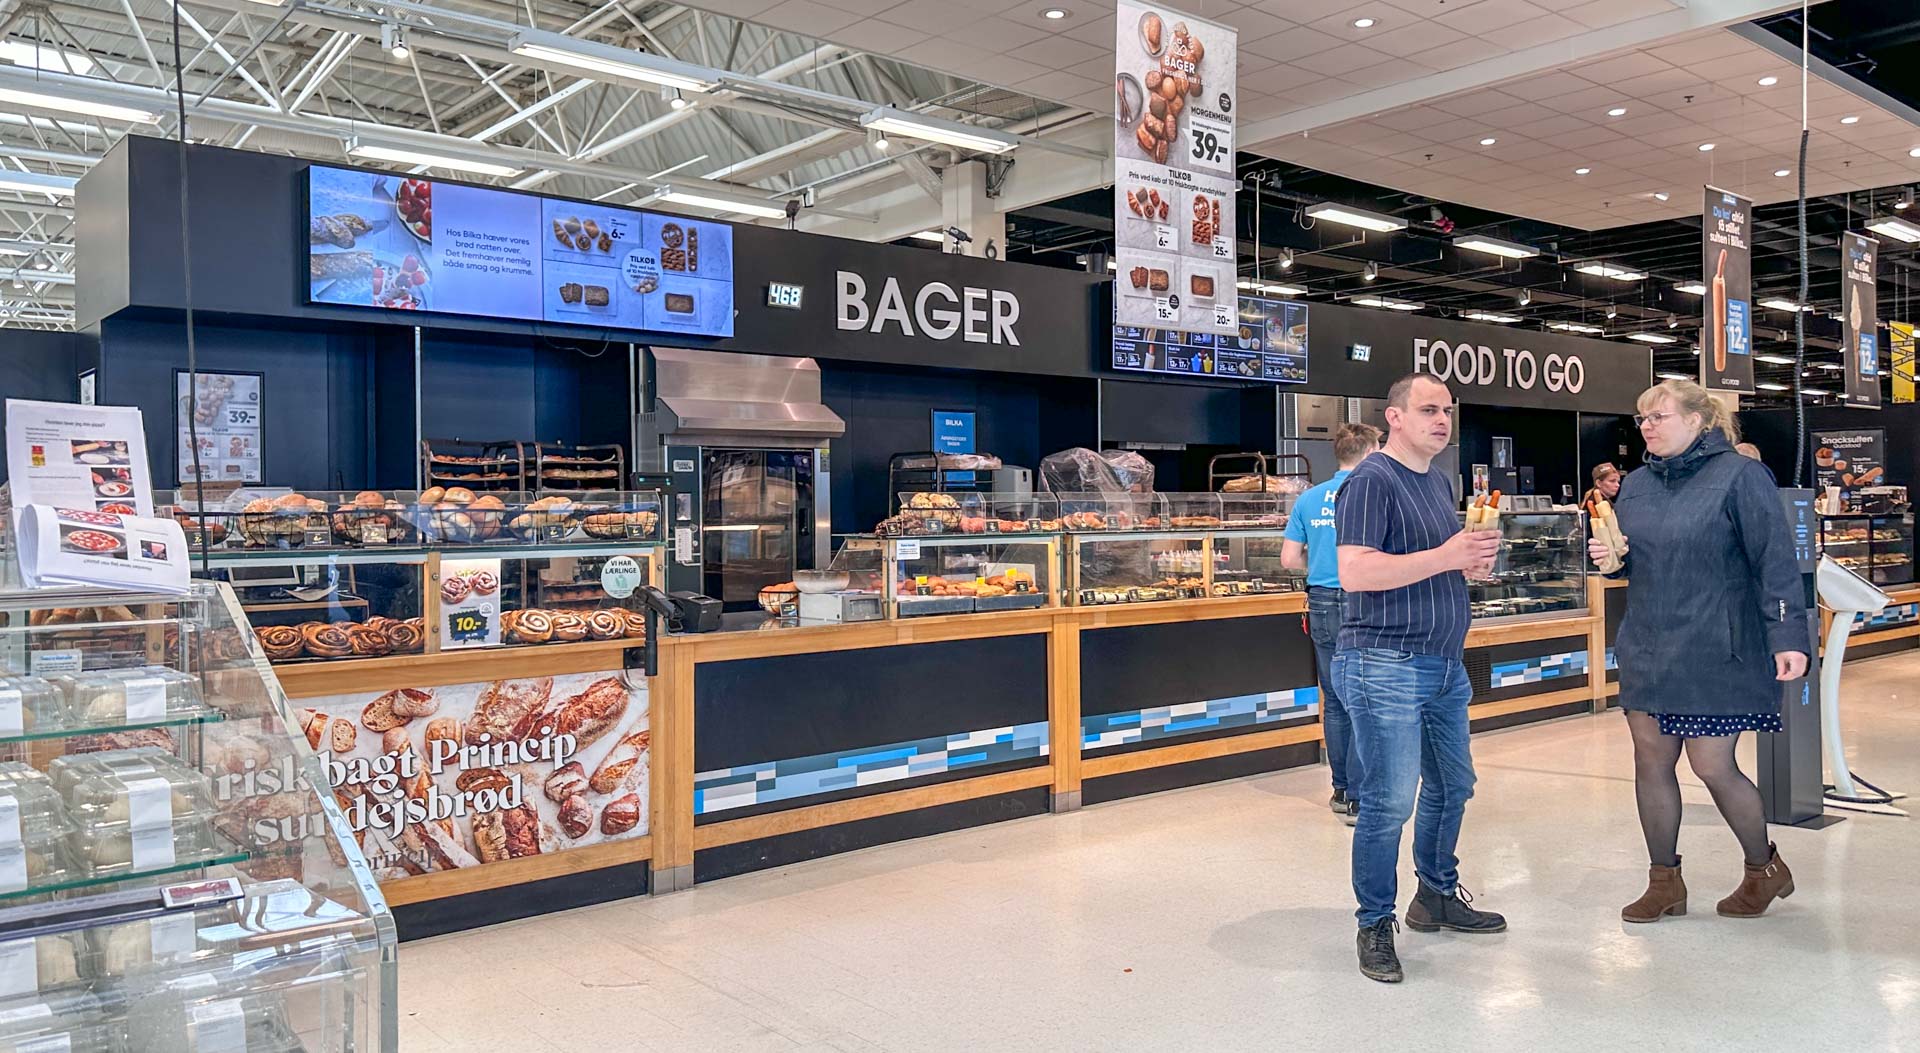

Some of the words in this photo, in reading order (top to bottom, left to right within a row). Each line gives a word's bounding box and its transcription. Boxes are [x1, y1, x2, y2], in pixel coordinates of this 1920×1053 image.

[1165, 56, 1195, 74] BAGER
[1191, 106, 1231, 123] MORGENMENU
[1192, 129, 1228, 163] 39.-
[1168, 169, 1192, 182] TILKØB
[446, 228, 461, 238] Hos
[463, 229, 481, 240] Bilka
[483, 232, 508, 243] hæver
[509, 238, 530, 246] vores
[1158, 236, 1169, 247] 6.-
[455, 240, 474, 249] brød
[476, 243, 501, 252] natten
[1215, 246, 1228, 257] 25.-
[445, 249, 460, 258] Det
[462, 250, 505, 262] fremhæver
[505, 256, 531, 267] nemlig
[629, 255, 655, 265] TILKØB
[443, 259, 464, 269] både
[489, 265, 500, 274] og
[770, 285, 800, 305] 468
[836, 270, 1020, 346] BAGER
[1158, 308, 1172, 319] 15.-
[1216, 314, 1230, 325] 20.-
[1413, 338, 1497, 385] FOOD
[1503, 348, 1537, 390] TO
[1543, 353, 1585, 394] GO
[229, 410, 256, 424] 39.-
[1821, 435, 1873, 445] Snacksulten
[1321, 507, 1335, 516] Du
[456, 616, 482, 632] 10.-
[430, 725, 577, 770] Princip
